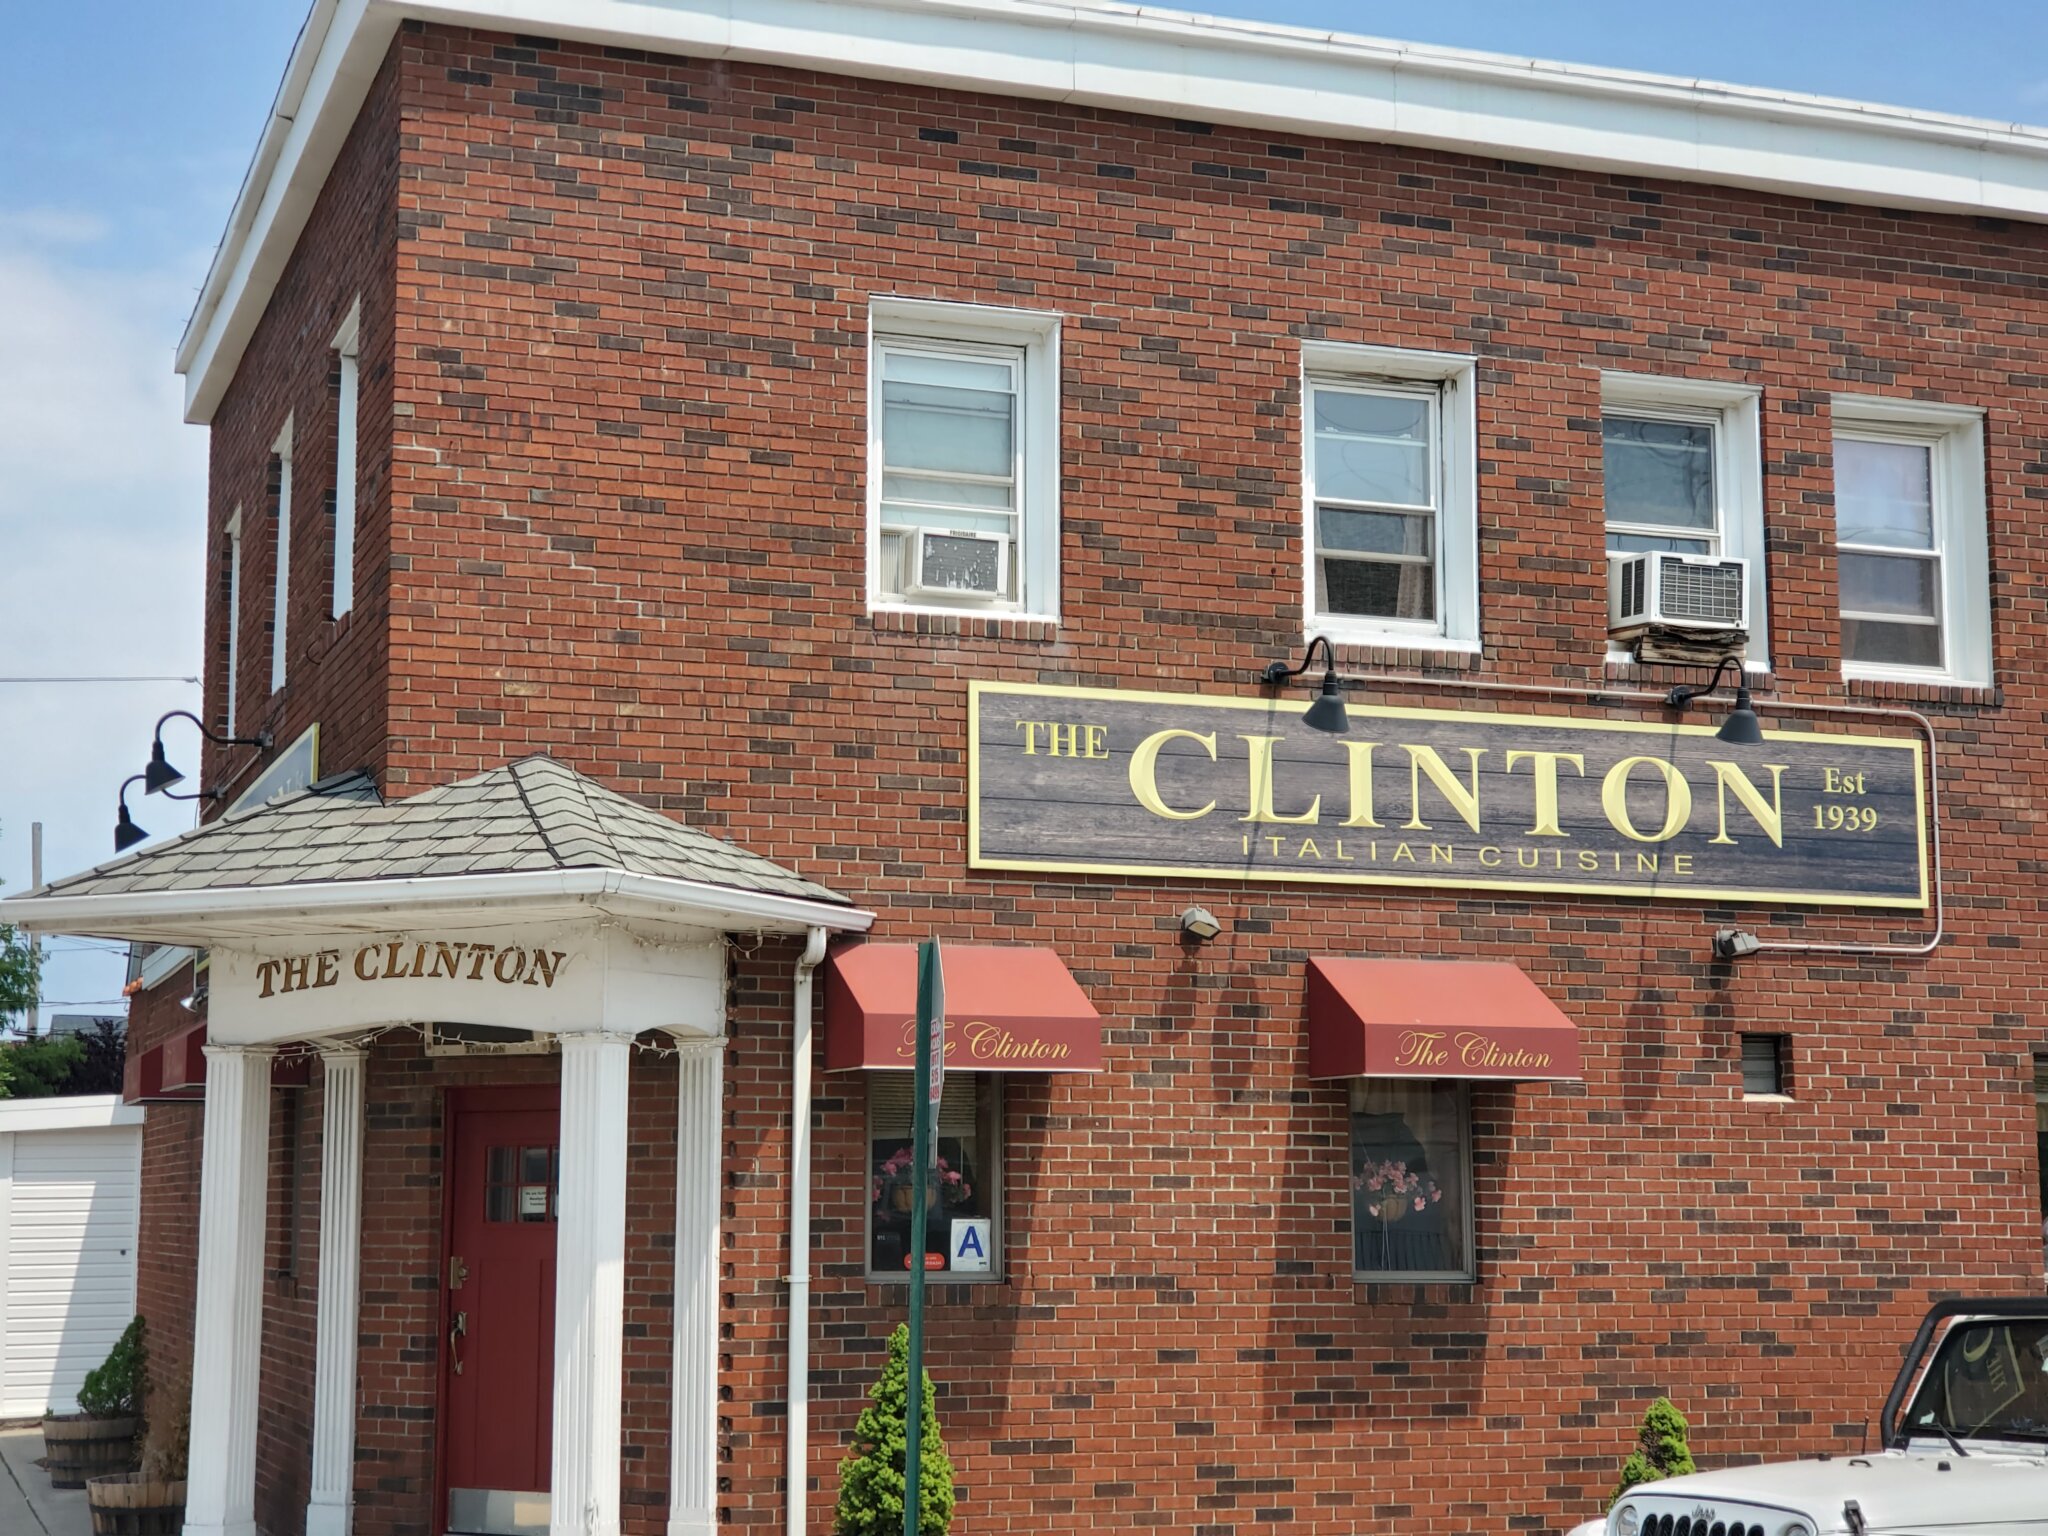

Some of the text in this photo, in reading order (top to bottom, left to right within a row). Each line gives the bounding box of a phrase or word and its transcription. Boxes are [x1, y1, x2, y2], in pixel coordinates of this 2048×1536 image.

[950, 530, 976, 538] FRIGIDAIRE
[1015, 720, 1790, 849] THE CLINTON
[1822, 767, 1867, 795] Est
[1812, 804, 1878, 832] 1939
[1242, 834, 1695, 875] ITALIAN CUISINE
[256, 941, 567, 998] THE CLINTON
[896, 1019, 957, 1057] Te
[963, 1021, 1072, 1059] Clinton
[1394, 1029, 1552, 1068] The Clinton
[956, 1226, 984, 1258] A
[1692, 1504, 1716, 1522] Jeep
